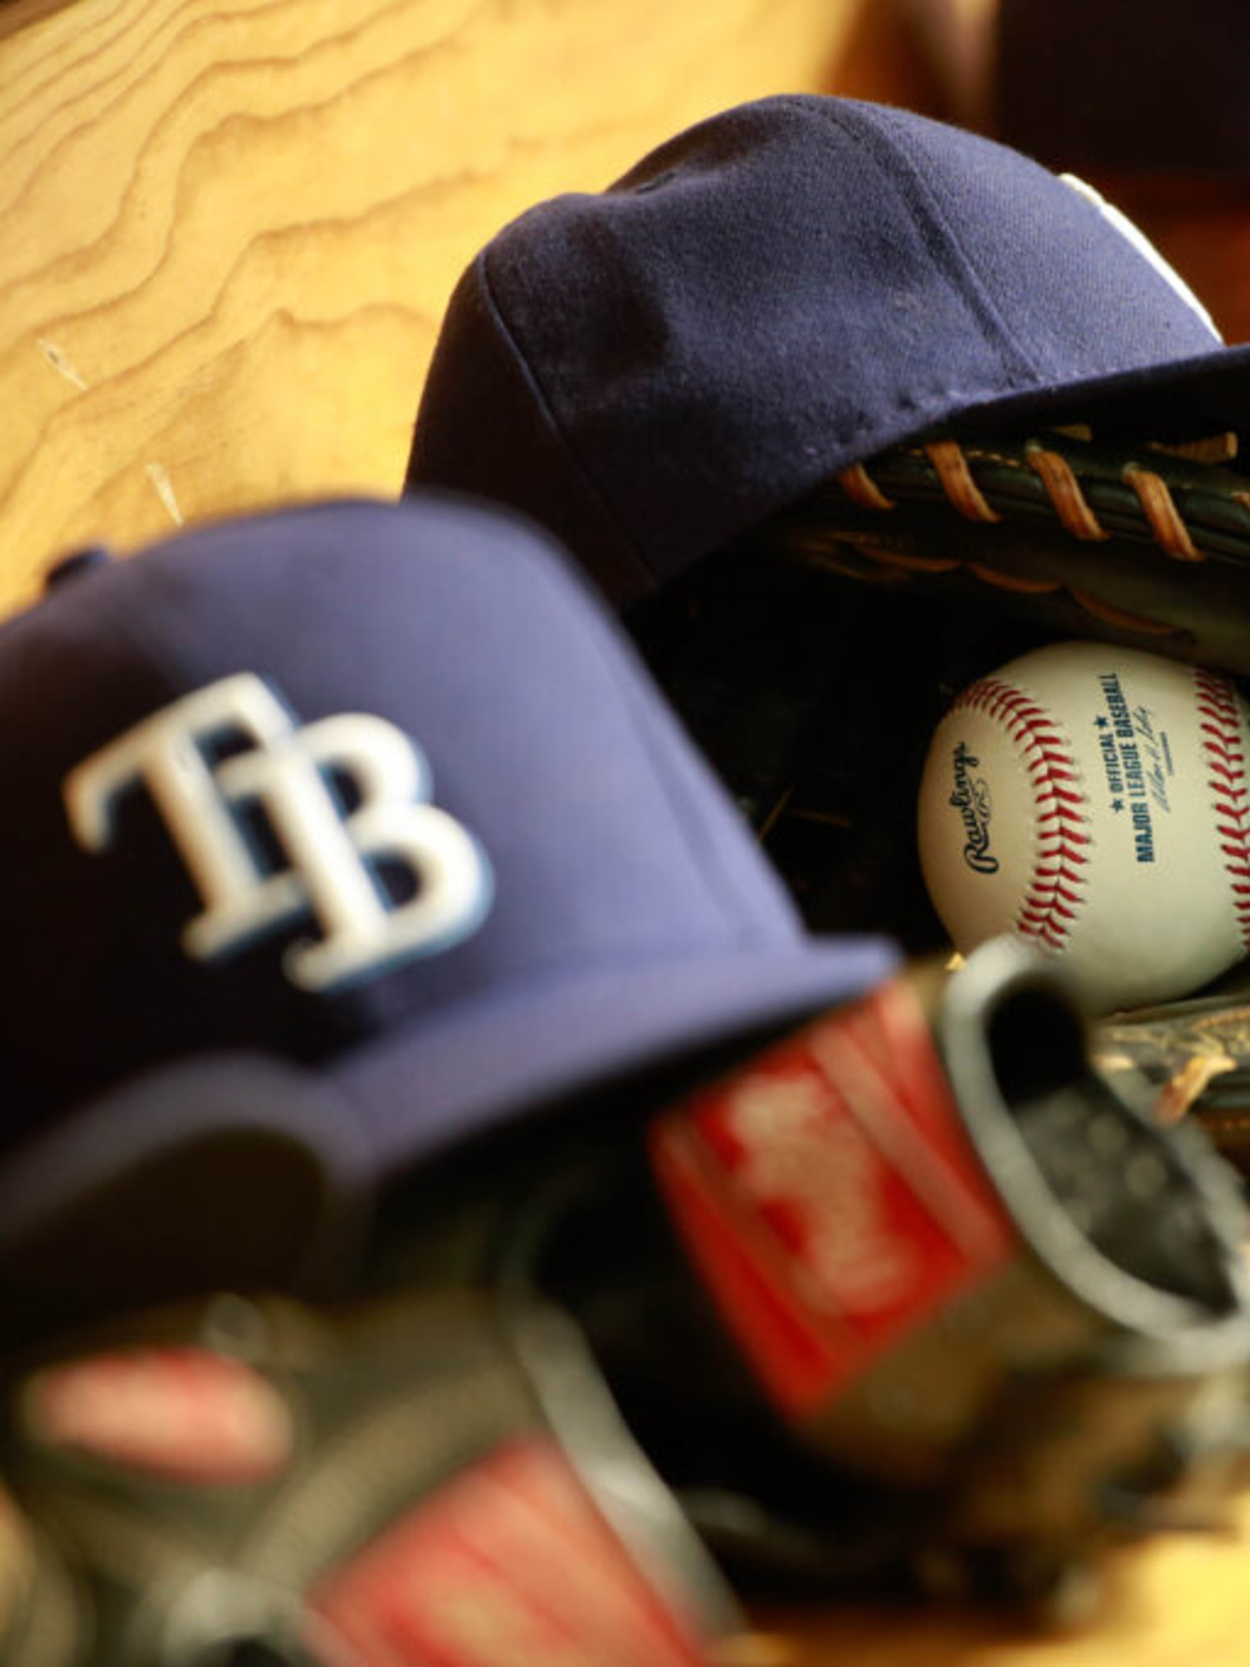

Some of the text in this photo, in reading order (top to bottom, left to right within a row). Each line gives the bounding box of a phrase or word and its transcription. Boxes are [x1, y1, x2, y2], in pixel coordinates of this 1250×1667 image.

[62, 669, 495, 993] TB
[948, 742, 999, 874] Rawlings
[1098, 673, 1154, 863] MAJOR LEAGUE BASEBALL
[1099, 733, 1124, 794] OFFICIAL
